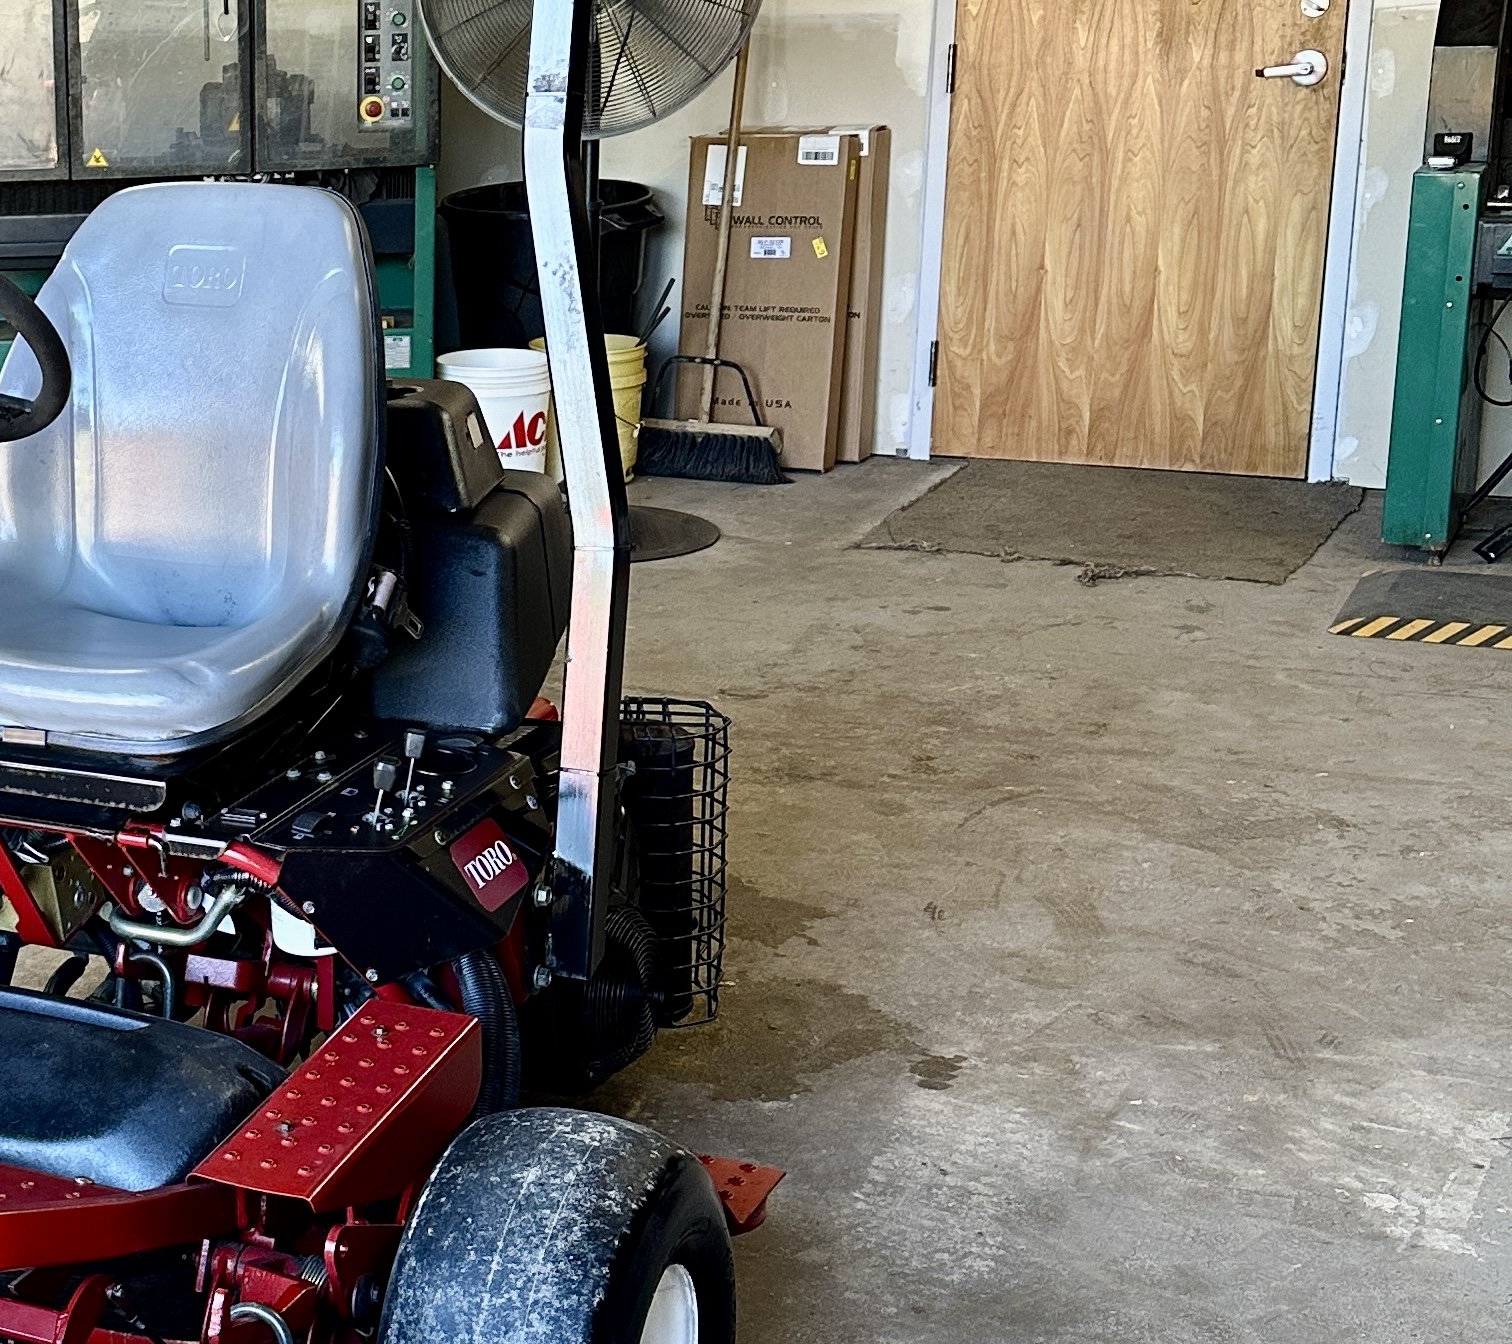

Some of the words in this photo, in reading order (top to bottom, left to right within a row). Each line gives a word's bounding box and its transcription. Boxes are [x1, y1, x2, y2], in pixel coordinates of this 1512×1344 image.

[732, 215, 764, 226] WALL
[768, 215, 823, 226] CONTROL
[171, 265, 237, 289] TORO
[695, 303, 731, 312] CAUON
[759, 305, 776, 313] LIFT
[778, 306, 821, 314] REQUIRED
[684, 312, 730, 320] OVERSED
[738, 313, 794, 322] OVERWEIGHT
[796, 315, 831, 323] CARTON
[765, 399, 793, 409] USA
[496, 410, 547, 449] AC
[464, 840, 513, 889] TORO
